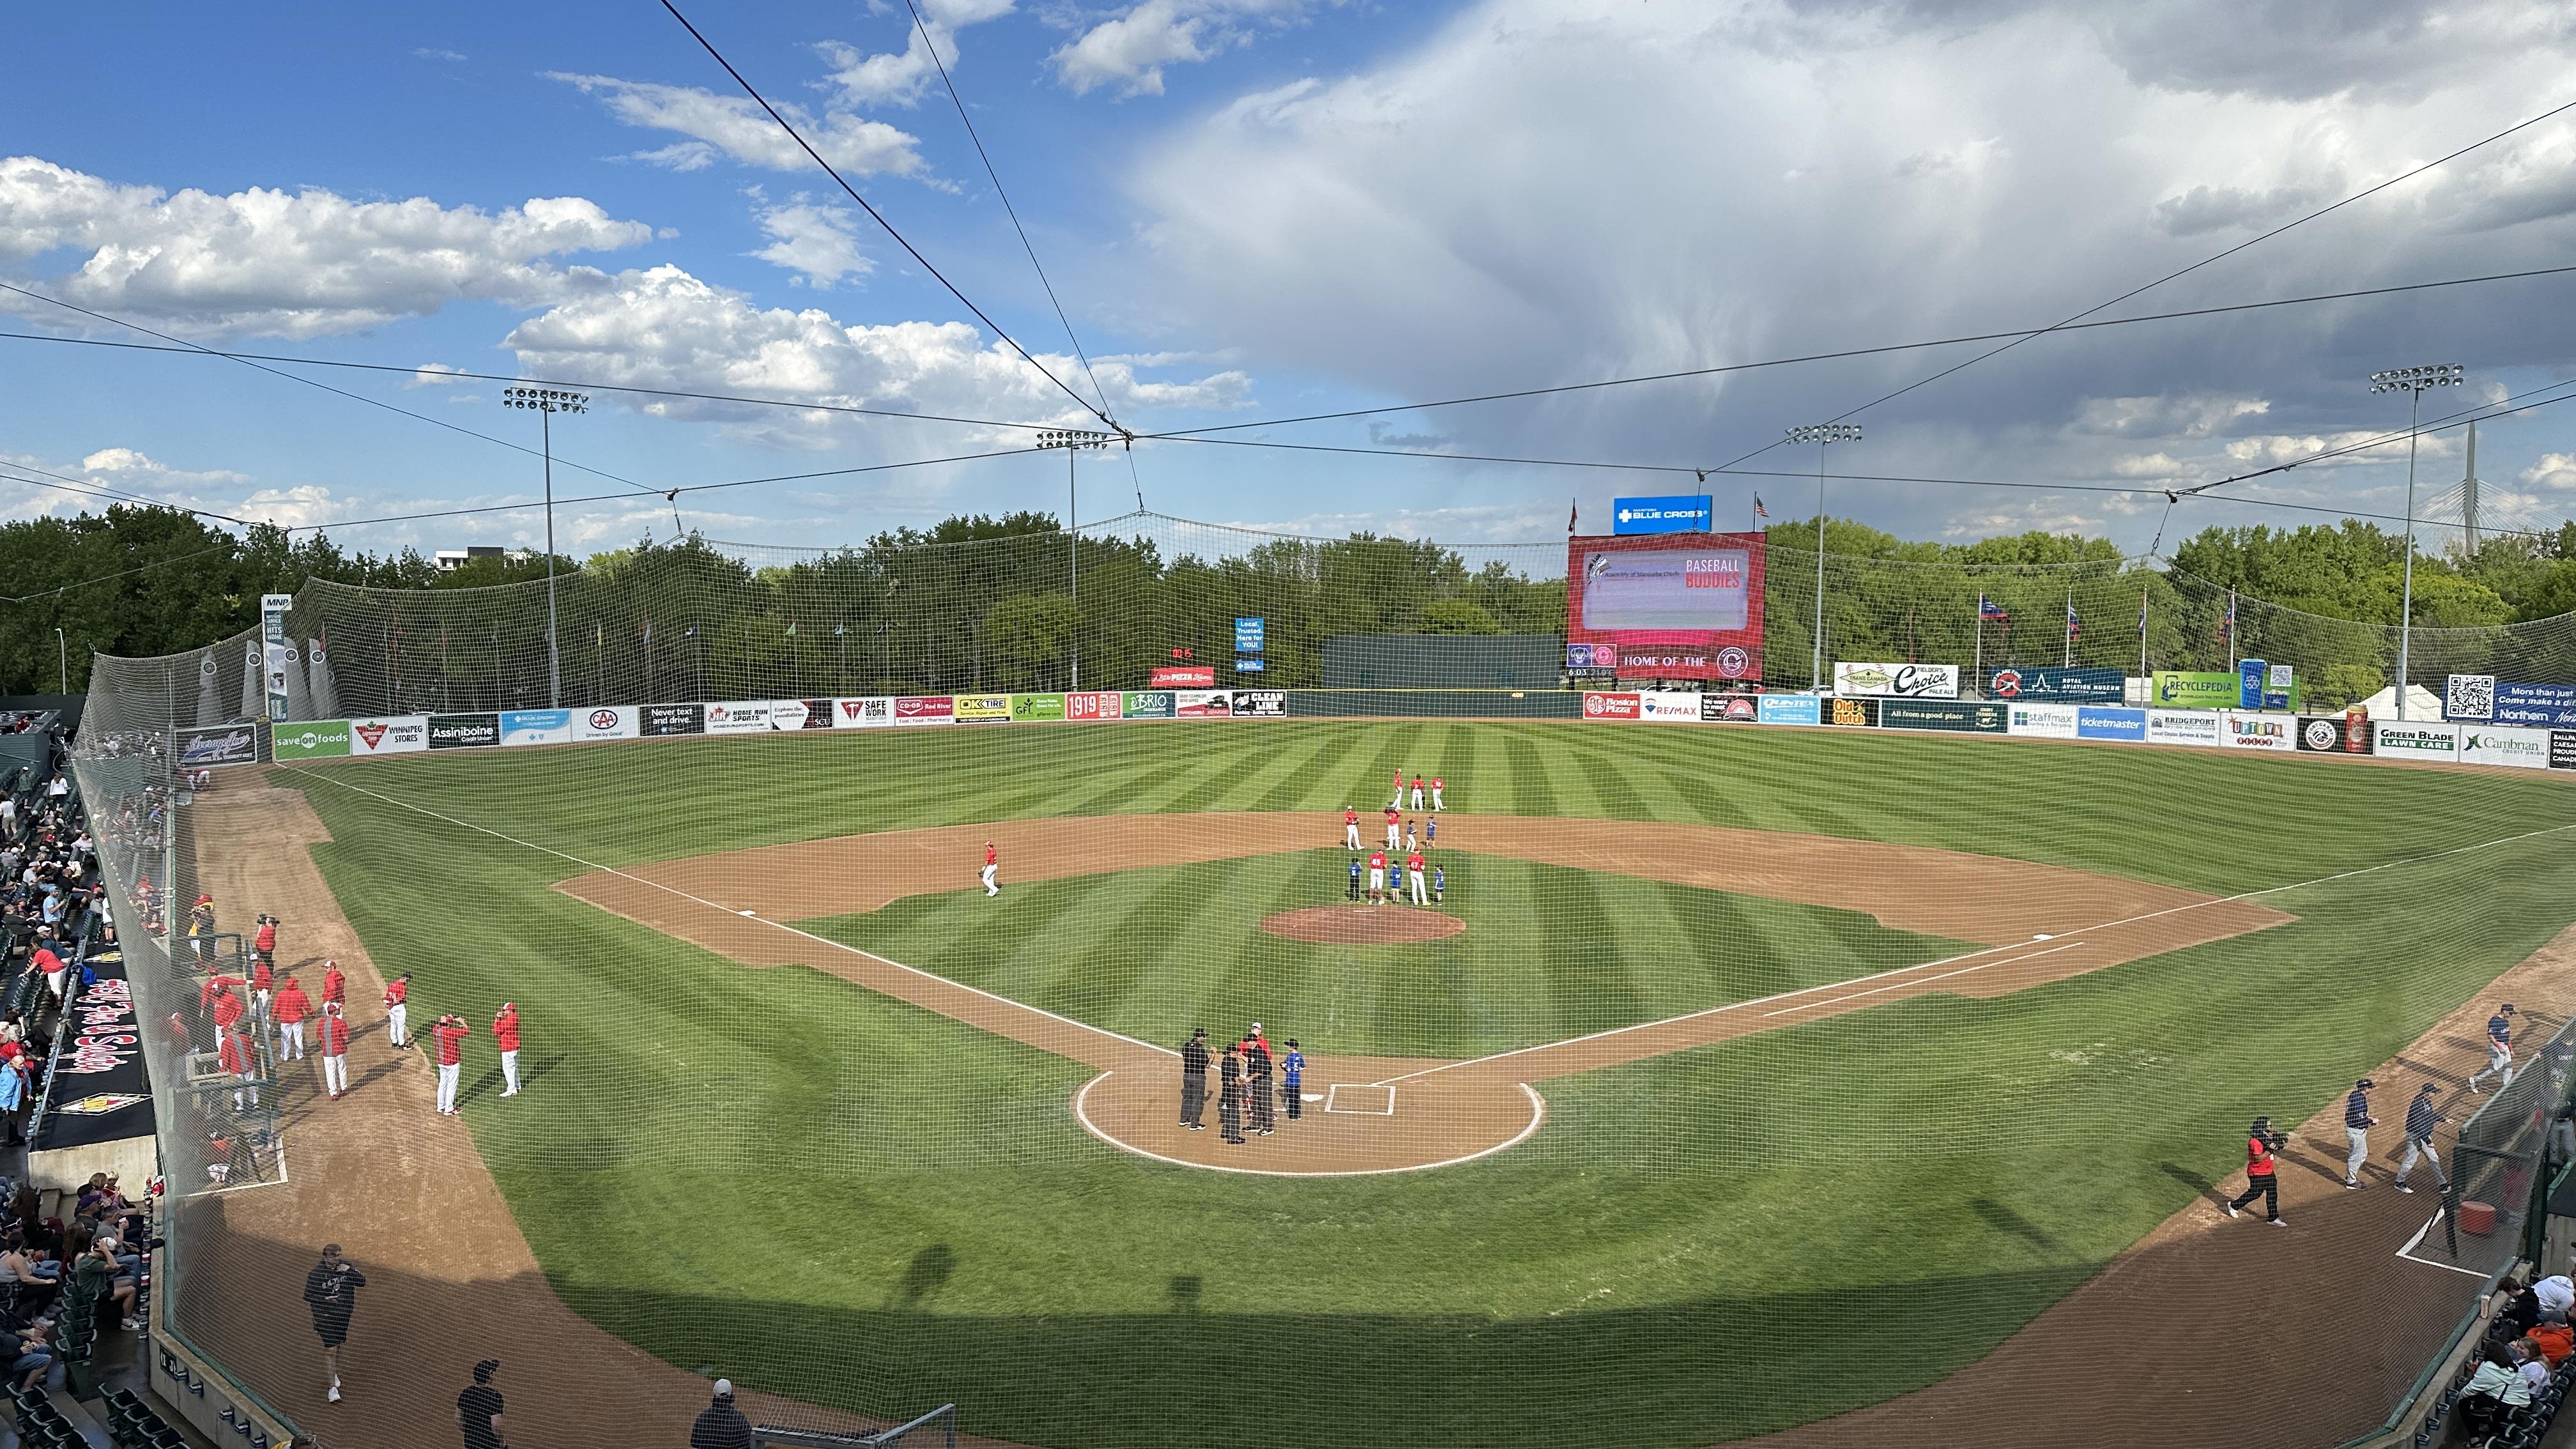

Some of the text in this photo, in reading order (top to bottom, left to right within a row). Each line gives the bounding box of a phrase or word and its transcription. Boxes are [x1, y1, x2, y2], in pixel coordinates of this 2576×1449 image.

[1687, 559, 1740, 572] BASEBALL
[1686, 572, 1740, 588] BUDDIES
[1625, 657, 1706, 667] HOME OF THE
[1894, 666, 1949, 695] Choice
[1251, 693, 1283, 702] CLEAN
[2536, 688, 2554, 697] than
[2557, 689, 2573, 698] just
[865, 701, 886, 709] SAFE
[960, 699, 982, 709] OK
[1255, 702, 1279, 710] LINE
[1606, 698, 1638, 706] Boston
[1763, 698, 1815, 709] QUINTEX
[1834, 699, 1854, 712] Old
[2499, 696, 2525, 705] Come
[1016, 703, 1033, 714] GFL
[1069, 696, 1097, 717] 1919
[1606, 705, 1632, 714] Pizza
[1657, 707, 1697, 715] RE/MAX
[593, 712, 615, 726] CAA
[713, 712, 726, 721] HR
[1834, 712, 1866, 725] Dutch
[2029, 713, 2073, 723] staffmax
[2165, 717, 2216, 725] BRIDGEPORT
[2081, 717, 2141, 729] ticketmaster
[388, 725, 423, 734] WINNIPEG
[433, 726, 494, 738] Assiniboine
[2233, 722, 2283, 736] UPTOWN
[2308, 723, 2333, 735] FORT GARRY
[277, 737, 300, 746] save
[318, 732, 348, 742] foods
[2380, 729, 2453, 741] GREEN BLADE
[2385, 739, 2449, 749] LAWN CARE
[2484, 737, 2538, 751] Cambrian
